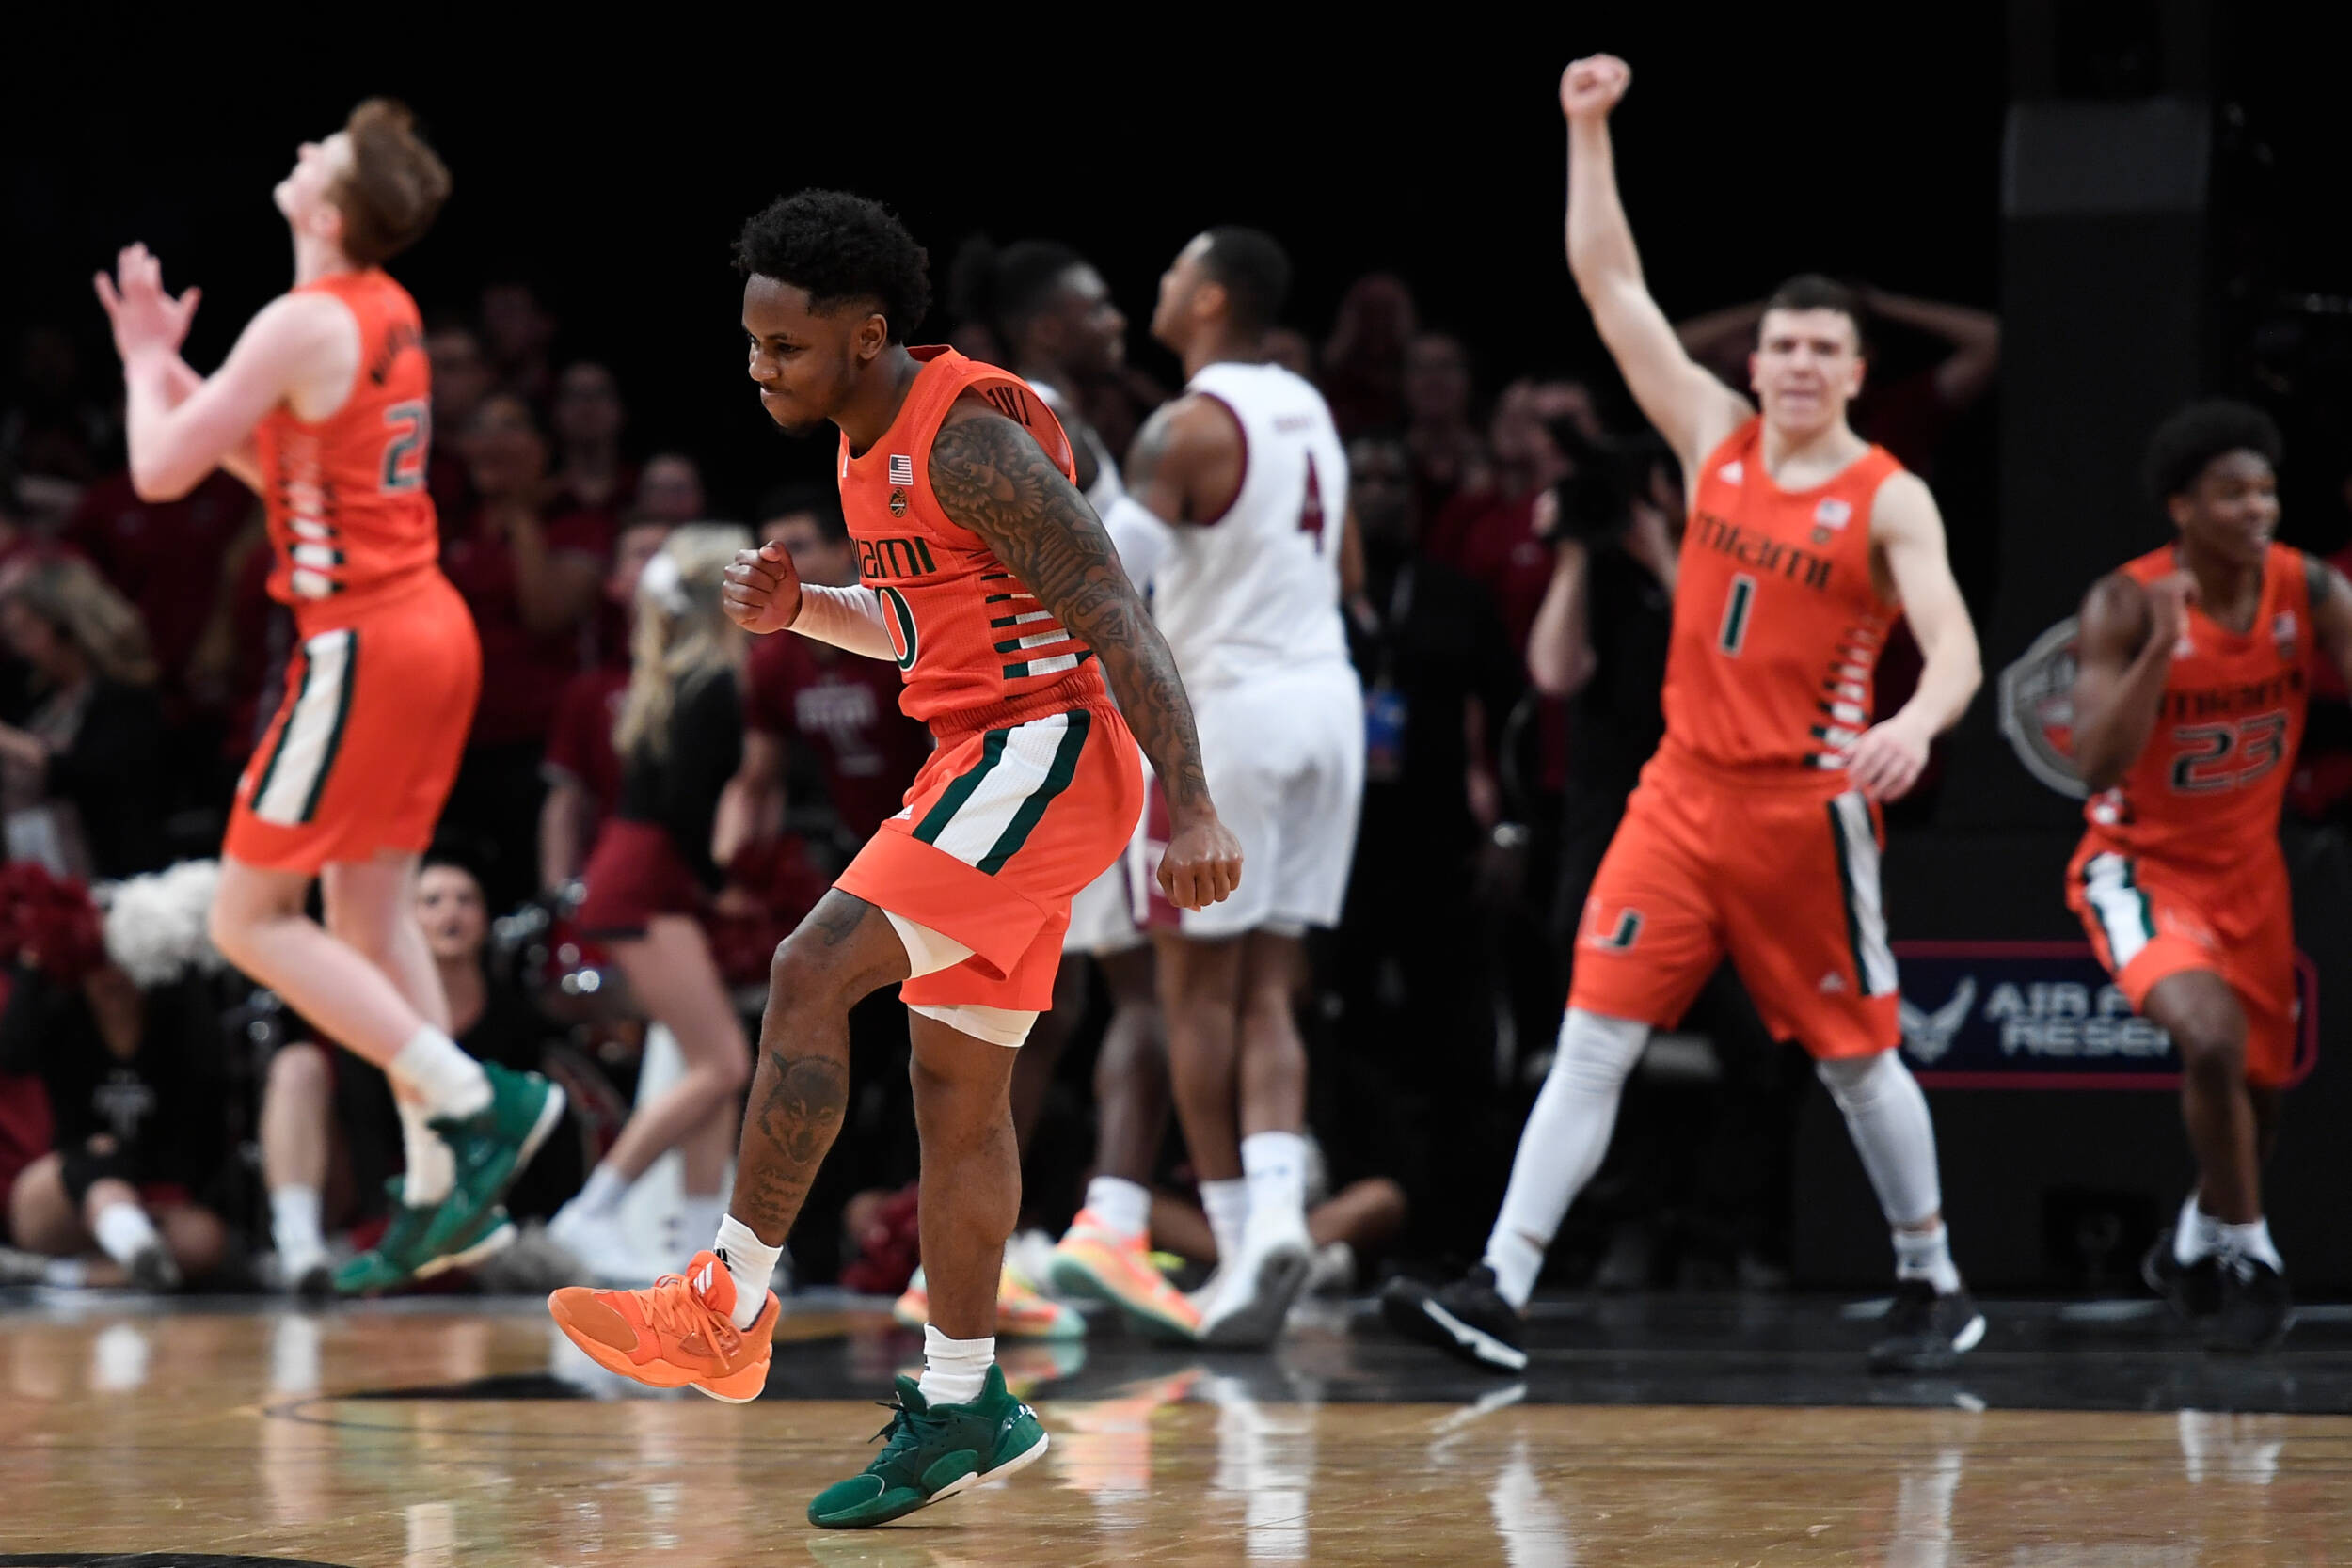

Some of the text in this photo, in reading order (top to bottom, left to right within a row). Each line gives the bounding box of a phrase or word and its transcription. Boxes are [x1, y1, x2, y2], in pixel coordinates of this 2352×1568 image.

[1295, 444, 1325, 557] 4
[874, 586, 918, 673] 0
[1716, 573, 1757, 657] 1
[2171, 709, 2289, 796] 23
[1983, 981, 2090, 1022] AIR
